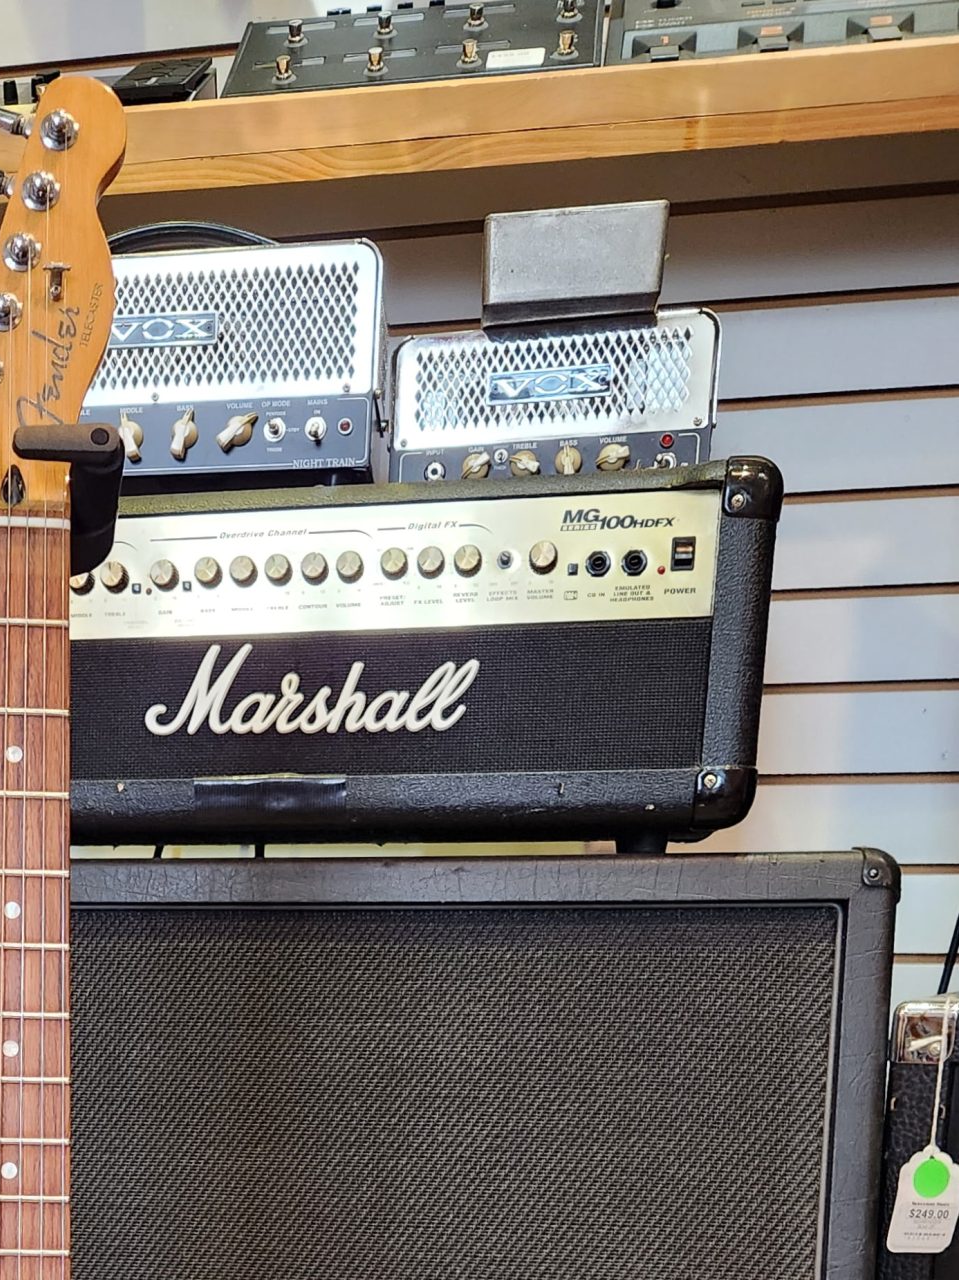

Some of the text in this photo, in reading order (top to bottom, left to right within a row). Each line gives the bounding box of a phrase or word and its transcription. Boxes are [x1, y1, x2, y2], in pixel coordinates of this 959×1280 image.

[79, 282, 104, 347] TELECASTER
[111, 318, 211, 342] VOX
[16, 306, 80, 427] Fender
[492, 369, 609, 398] VOX
[599, 436, 627, 444] VOLUME
[513, 442, 538, 450] TREBLE
[292, 458, 357, 469] NIGHT TRAIN
[408, 520, 458, 531] Digital FX
[219, 529, 307, 540] Overdrive Channel
[144, 643, 481, 736] Marshall
[909, 1209, 950, 1219] $249.00
